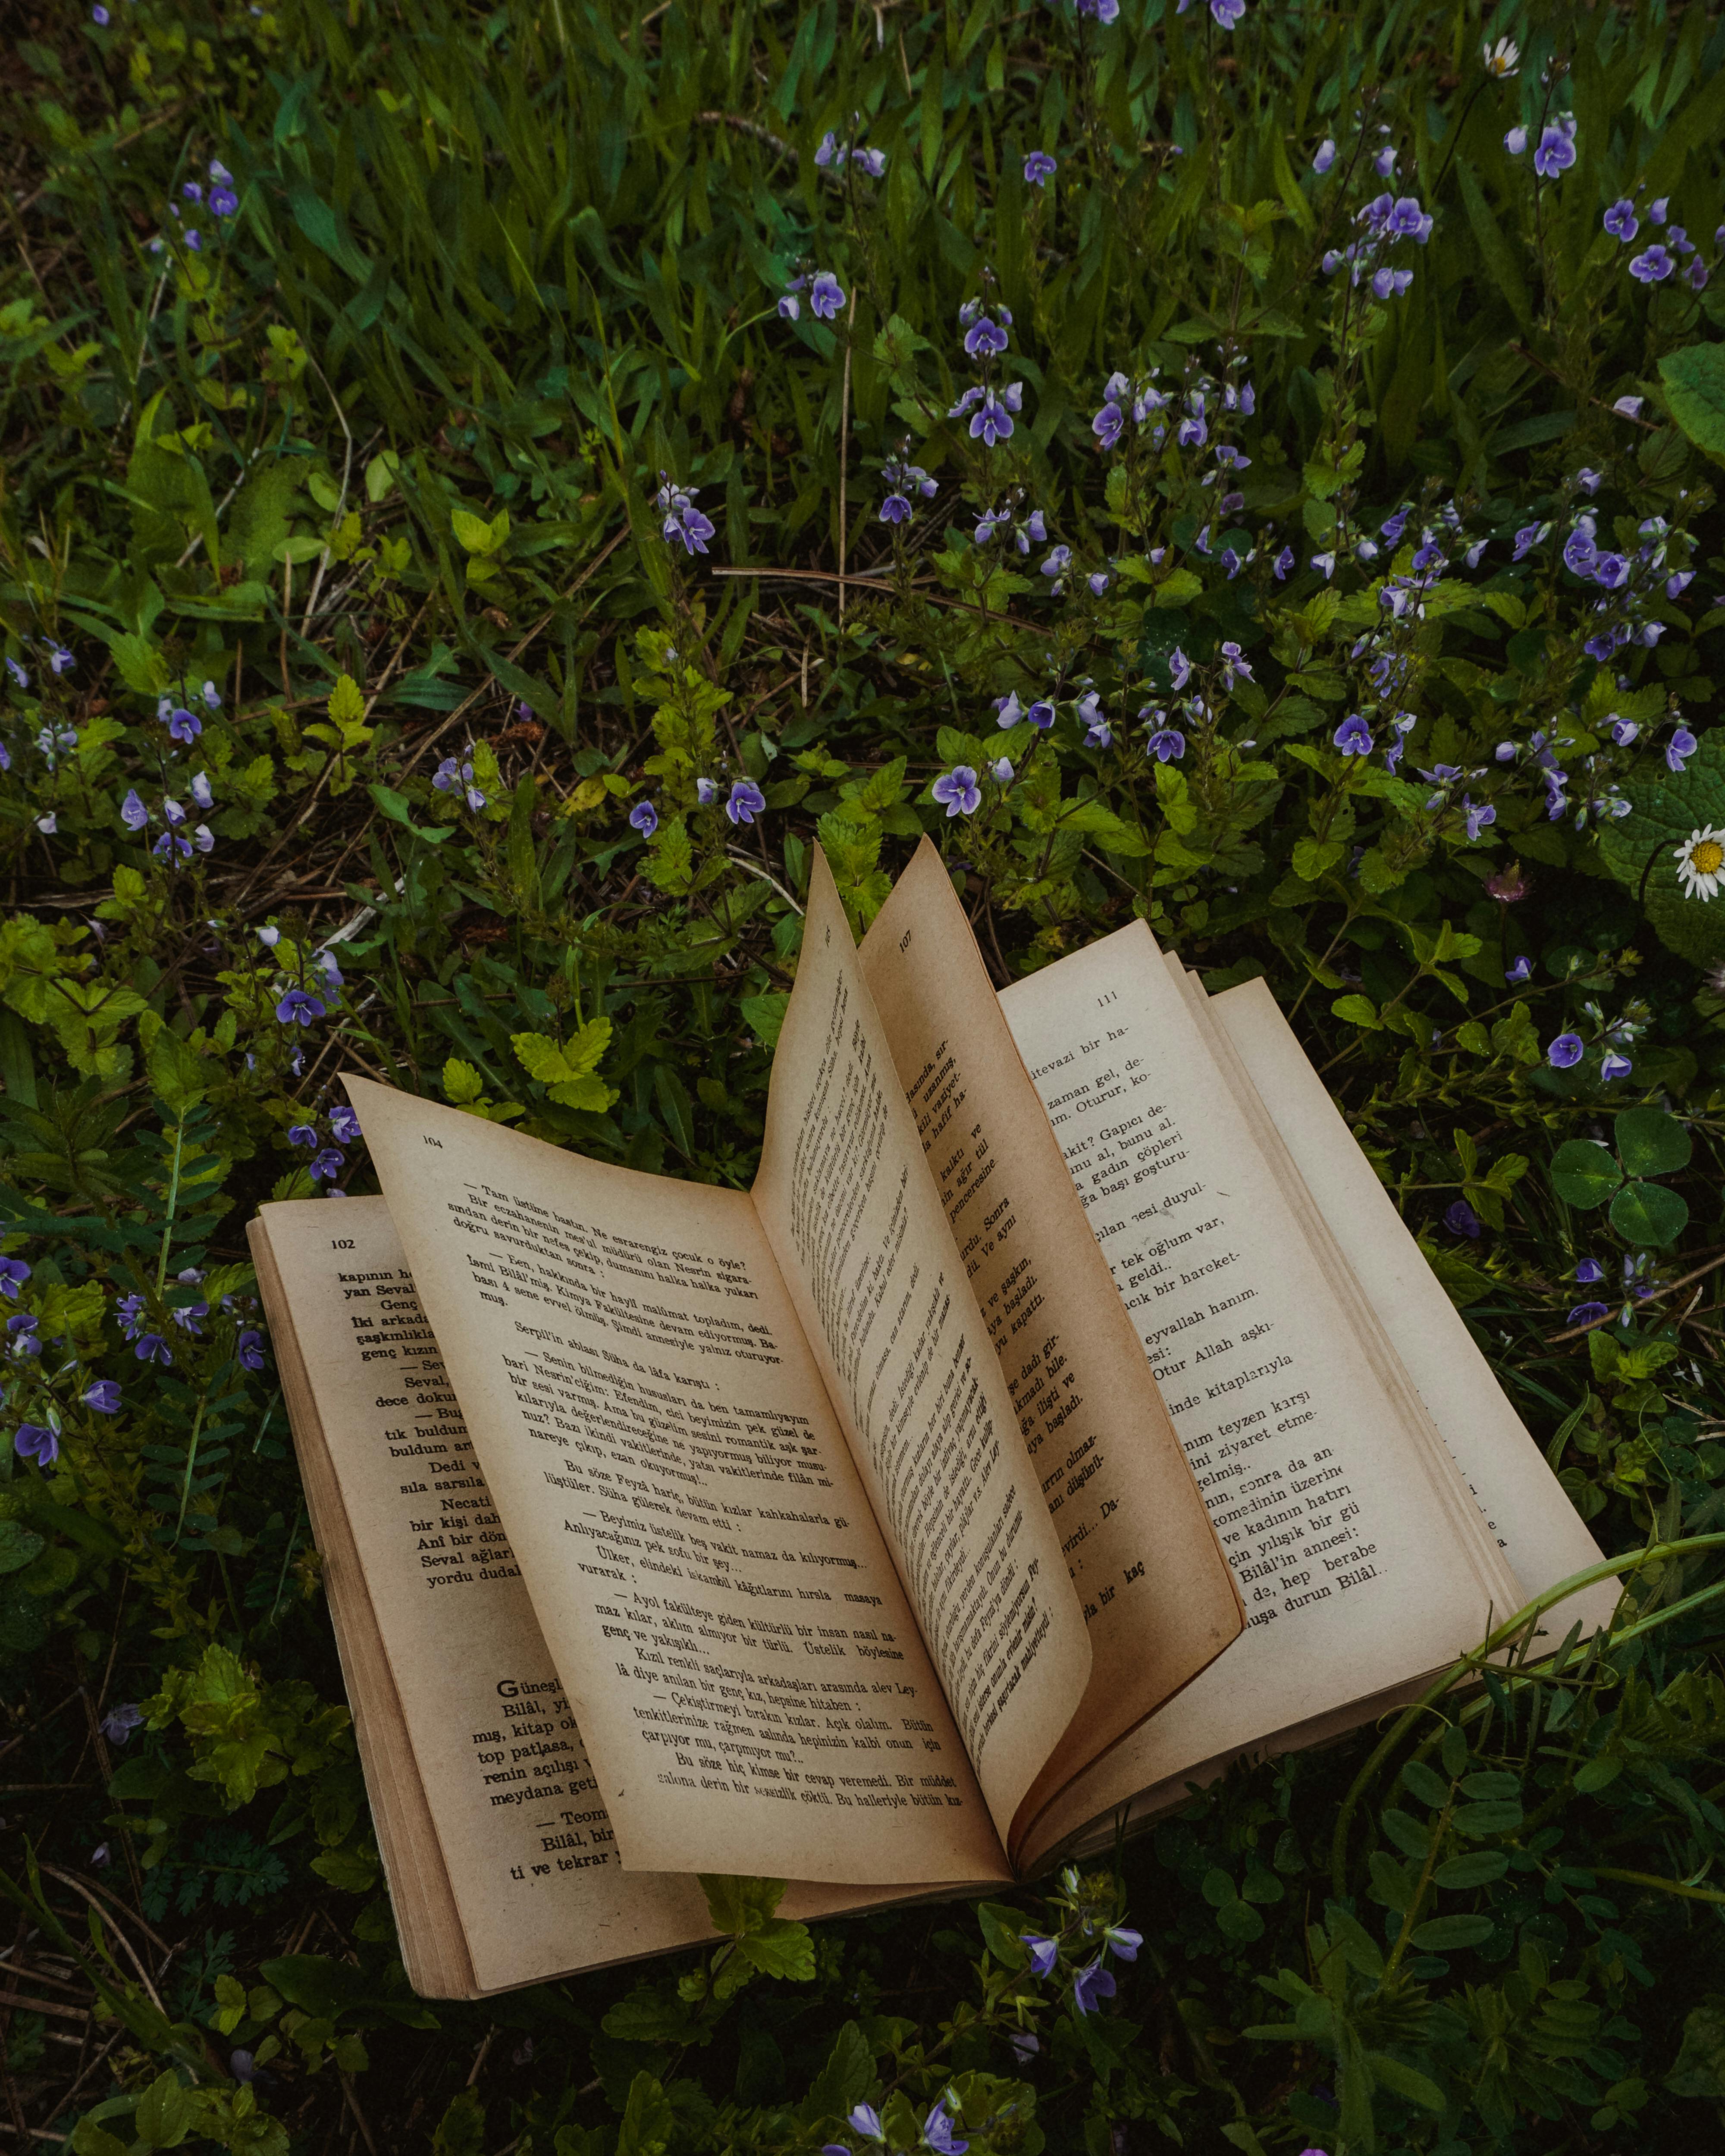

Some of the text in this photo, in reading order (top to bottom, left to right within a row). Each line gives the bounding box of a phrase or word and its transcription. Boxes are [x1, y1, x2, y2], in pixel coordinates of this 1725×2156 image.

[899, 929, 911, 953] 107
[1098, 991, 1117, 1007] 111
[935, 1040, 948, 1060] sır-
[1079, 1028, 1129, 1054] bir ha-
[923, 1056, 956, 1103] uzanmış,
[1047, 1059, 1144, 1110] zaman gel, de-
[932, 1073, 961, 1114] vaziyet-
[1076, 1074, 1151, 1112] Oturur, ko-
[931, 1105, 953, 1140] hafif
[1100, 1106, 1167, 1140] Gapıcı de-
[423, 1135, 443, 1149] 104
[1097, 1117, 1176, 1161] al, bunu al.
[940, 1148, 965, 1183] kalktı
[956, 1138, 989, 1188] ağır tül
[1091, 1131, 1182, 1185] gadın çöpleri
[1099, 1151, 1190, 1196] başı goşturu-
[949, 1159, 997, 1224] penceresine
[1163, 1182, 1206, 1208] duyul-
[984, 1197, 1010, 1232] Sonra
[481, 1185, 509, 1202] Tam
[513, 1196, 549, 1217] üstüne
[591, 1226, 608, 1240] Ne
[612, 1236, 668, 1256] esrarengiz
[672, 1251, 703, 1263] çocuk
[718, 1258, 746, 1271] öyle?
[980, 1214, 1016, 1257] Ve aynı
[332, 1240, 355, 1249] 102
[1121, 1218, 1224, 1269] tek oğlum var,
[337, 1272, 394, 1284] kapının
[1001, 1258, 1032, 1296] şaşkın,
[1129, 1262, 1171, 1288] geldi..
[1153, 1252, 1240, 1296] bir hareket-
[342, 1288, 372, 1300] yan
[380, 1299, 418, 1311] Genç
[1003, 1275, 1038, 1316] başladı.
[471, 1271, 499, 1288] bası
[502, 1281, 511, 1292] 4
[514, 1287, 539, 1300] sene
[543, 1297, 572, 1313] evvel
[611, 1319, 643, 1338] Şimdi
[646, 1332, 695, 1351] annesiyle
[698, 1344, 732, 1356] yalnız
[734, 1349, 784, 1365] oturuyor-
[1010, 1294, 1045, 1335] kapattı.
[1145, 1289, 1258, 1344] eyvallah hanım.
[361, 1345, 439, 1362] genç kızın
[1153, 1323, 1274, 1381] Otur Allah aşkı-
[1021, 1354, 1041, 1380] dadı
[1045, 1355, 1067, 1379] bile.
[1204, 1356, 1293, 1399] kitaplarıyla
[404, 1375, 450, 1388] Seval,
[375, 1396, 409, 1407] dece
[1036, 1385, 1060, 1417] ilişti
[1045, 1394, 1083, 1435] başladı.
[1217, 1410, 1267, 1436] teyzen
[384, 1429, 408, 1441] tık
[1217, 1411, 1317, 1459] ziyaret etme-
[388, 1443, 448, 1457] buldum
[1066, 1435, 1097, 1470] olmaz-
[428, 1460, 466, 1473] Dedi
[1288, 1460, 1307, 1473] da
[400, 1476, 486, 1494] sıla sarsıla
[564, 1459, 583, 1474] Bu
[587, 1467, 612, 1482] söze
[615, 1473, 650, 1492] Feyzâ
[651, 1483, 684, 1504] hariç,
[686, 1494, 718, 1512] bütün
[720, 1502, 753, 1517] kızlar
[756, 1507, 831, 1525] kahkahalarla
[439, 1495, 492, 1511] Necati
[1221, 1485, 1352, 1545] ve kadının hatırı
[409, 1519, 434, 1532] bir
[439, 1515, 469, 1529] kişi
[1257, 1515, 1332, 1557] yılışık bir
[448, 1533, 474, 1546] bir
[420, 1551, 465, 1568] Seval
[1239, 1554, 1298, 1584] Bilâl'in
[426, 1570, 474, 1589] yordu
[1098, 1561, 1145, 1607] bir kaç
[1279, 1571, 1311, 1590] hep
[1284, 1587, 1332, 1612] durun
[634, 1647, 665, 1664] Kızıl
[667, 1656, 701, 1671] renkli
[703, 1664, 755, 1684] saçlarıyla
[757, 1674, 818, 1692] arkadaşları
[820, 1681, 868, 1693] arasında
[871, 1681, 892, 1693] alev
[501, 1700, 546, 1718] Bilâl,
[471, 1720, 554, 1744] mış, kitap
[477, 1751, 505, 1765] top
[480, 1767, 528, 1785] renin
[489, 1781, 564, 1806] meydana
[540, 1831, 587, 1852] Bilâl,
[510, 1853, 608, 1880] ti ve tekrar
